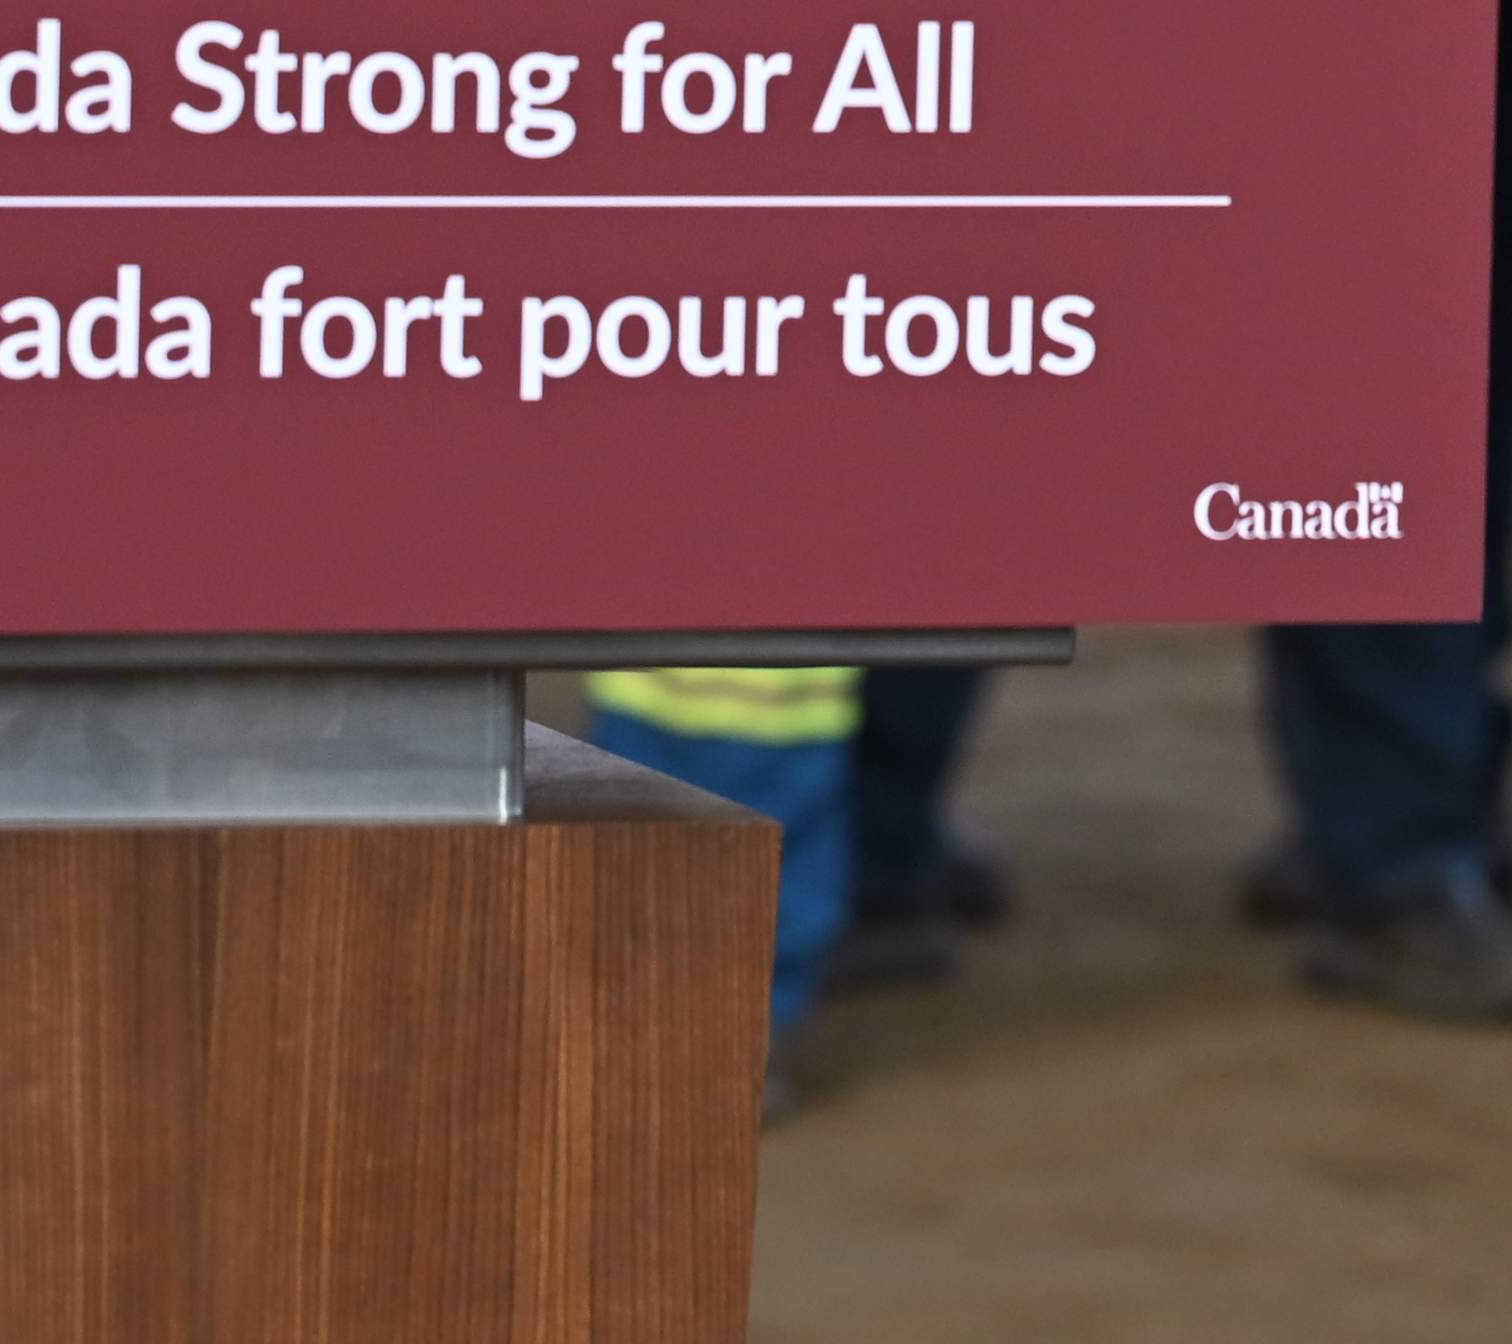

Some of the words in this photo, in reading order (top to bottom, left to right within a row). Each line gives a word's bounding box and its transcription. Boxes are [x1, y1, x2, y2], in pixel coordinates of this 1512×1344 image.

[171, 20, 580, 159] Strong
[611, 20, 793, 134] for
[812, 20, 975, 134] All
[250, 265, 484, 379] fort
[519, 295, 805, 402] pour
[832, 273, 1096, 377] tous
[1193, 481, 1404, 541] Canada
